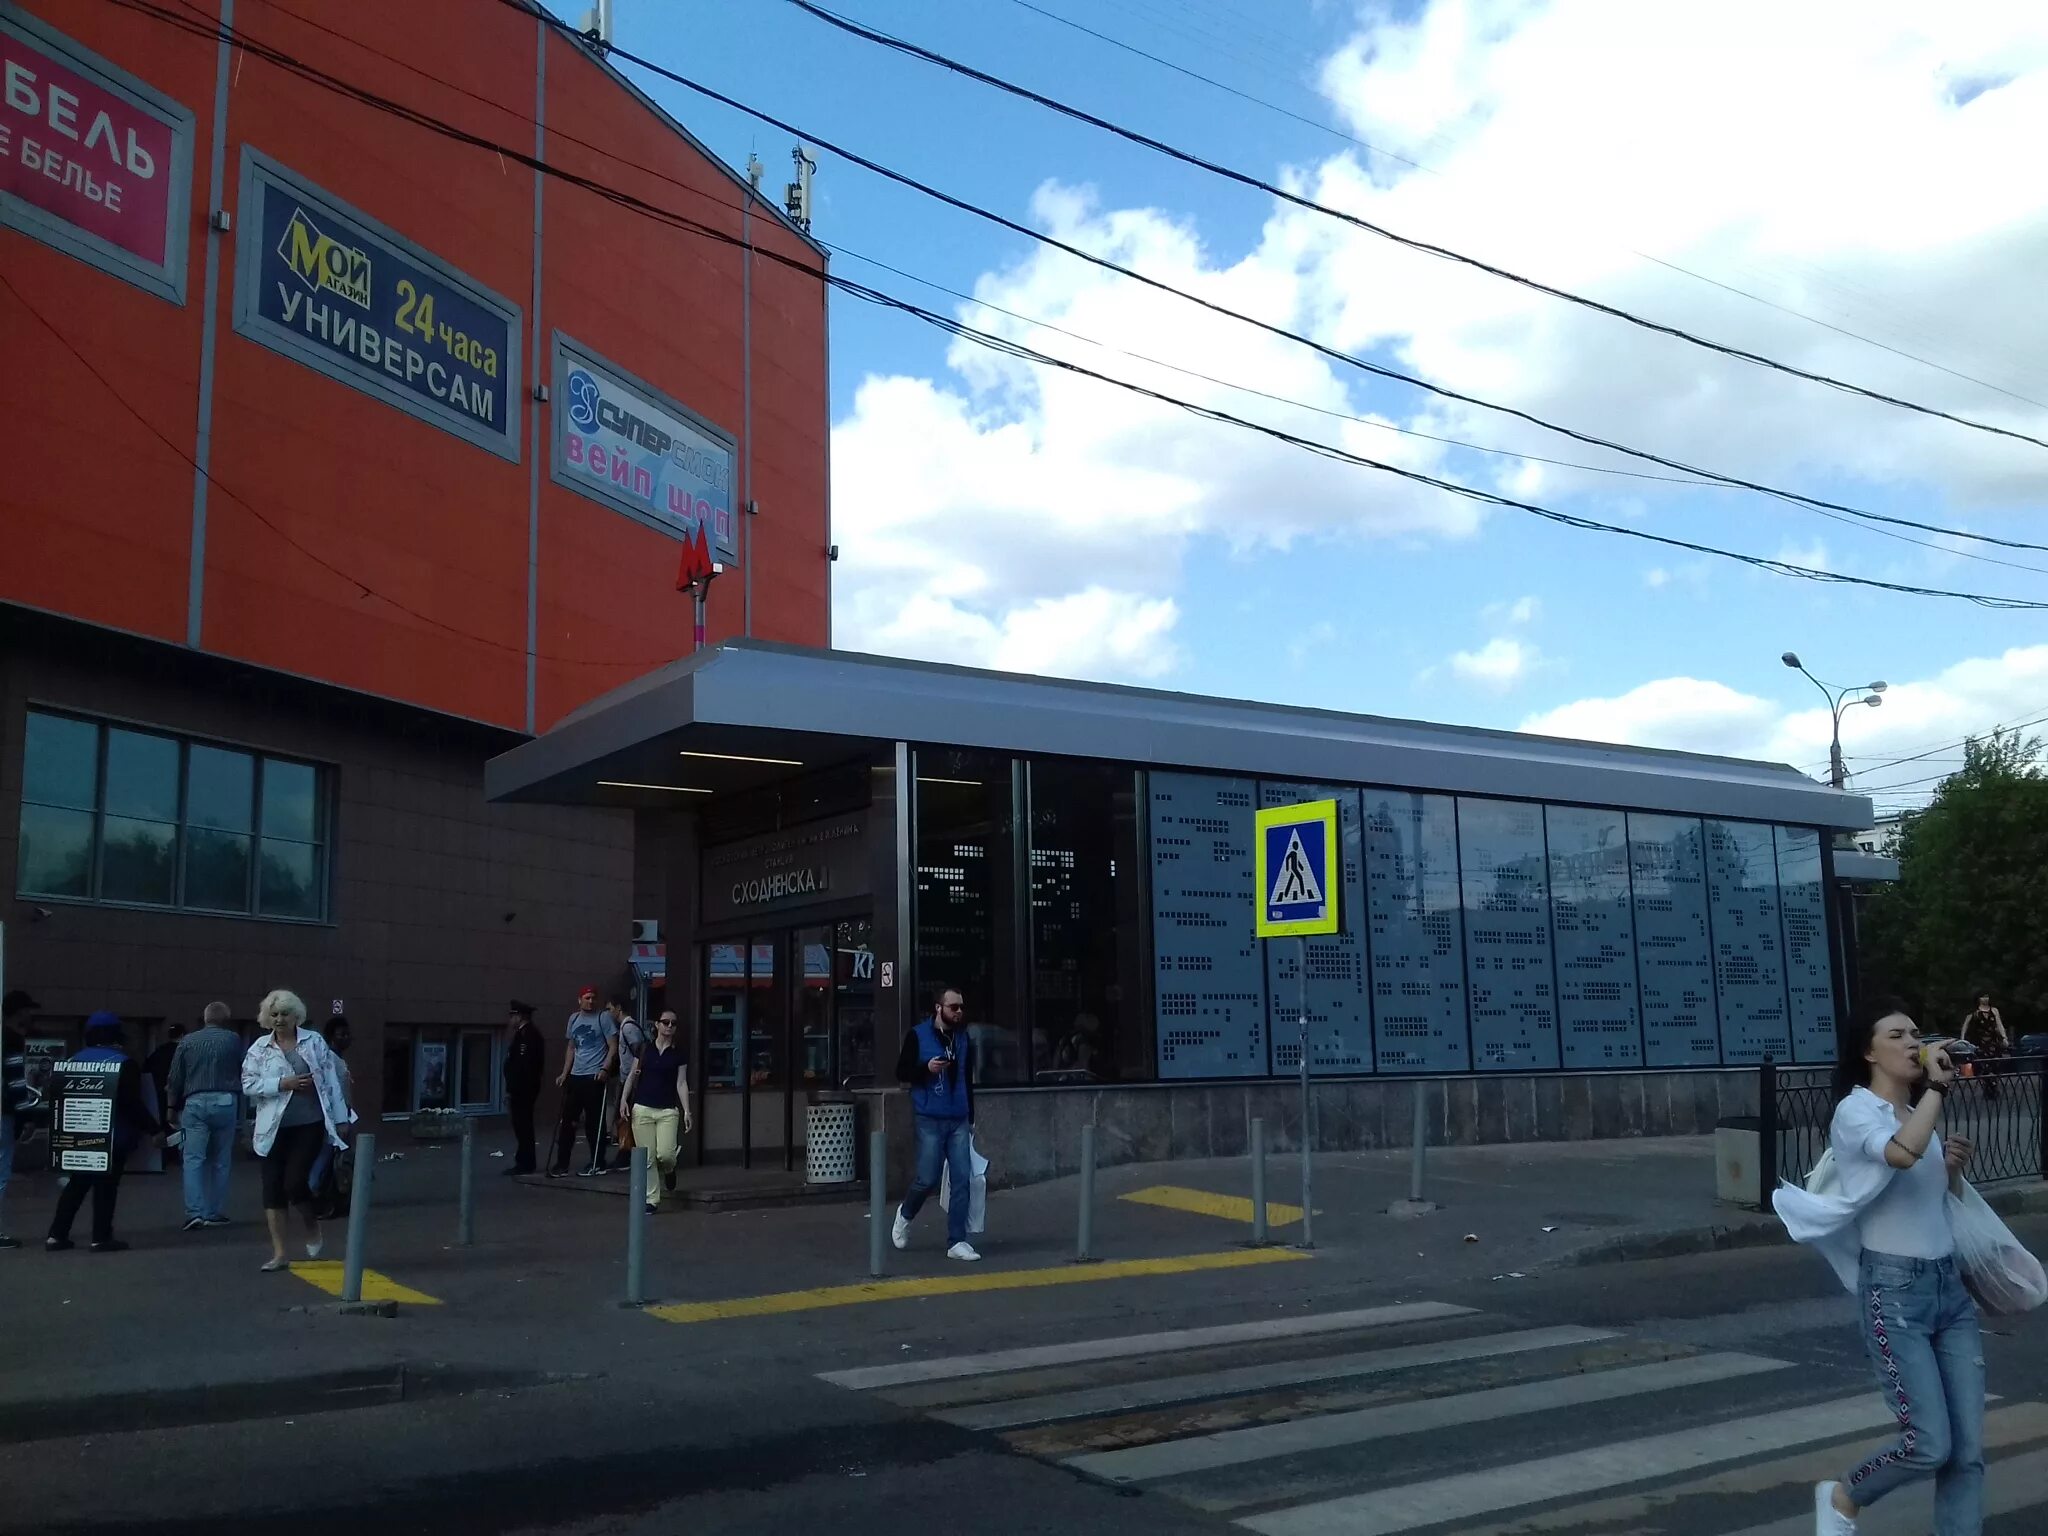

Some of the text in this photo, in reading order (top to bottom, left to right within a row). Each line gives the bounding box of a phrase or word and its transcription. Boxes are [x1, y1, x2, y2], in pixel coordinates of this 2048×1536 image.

[5, 59, 155, 179] БЕЛЬ
[21, 136, 122, 213] БЕЛЬЕ
[289, 219, 368, 292] МОЙ
[277, 281, 494, 422] УНИВЕРСАМ
[394, 279, 498, 379] 24 часа
